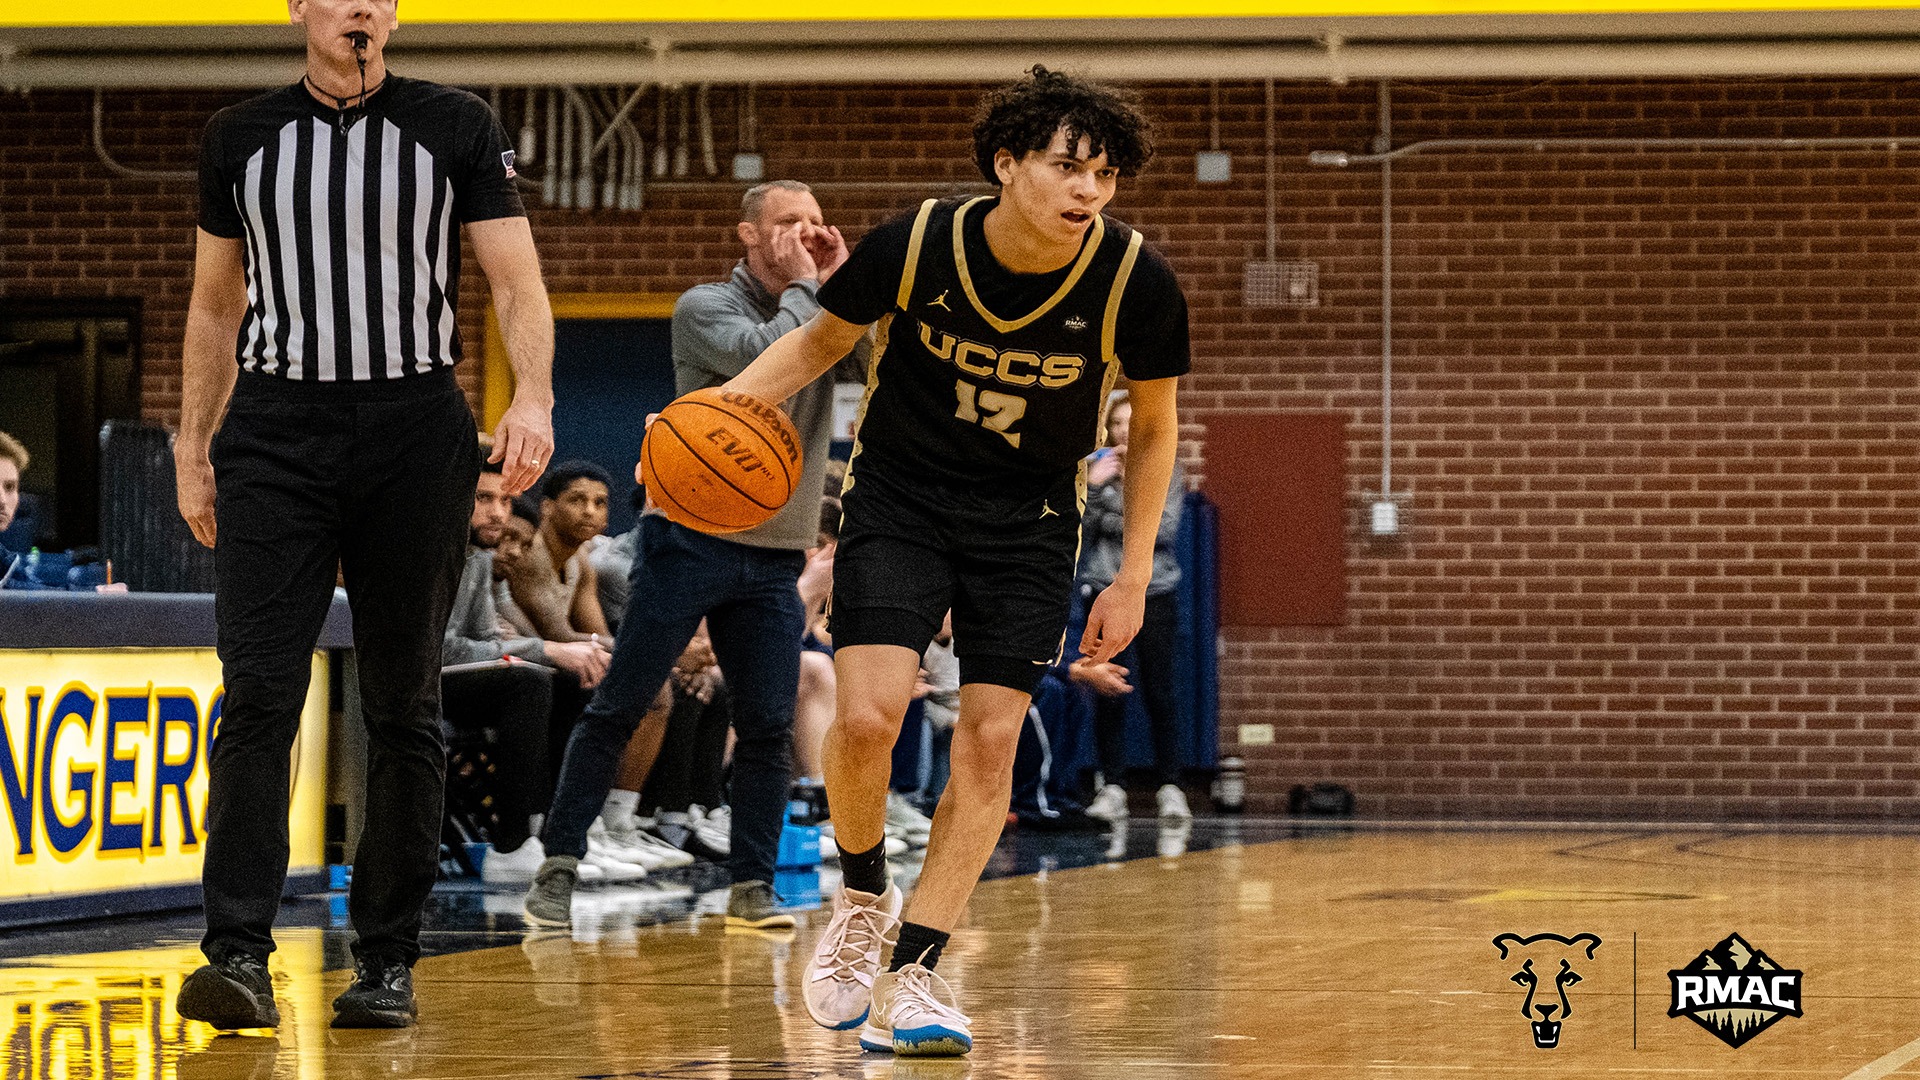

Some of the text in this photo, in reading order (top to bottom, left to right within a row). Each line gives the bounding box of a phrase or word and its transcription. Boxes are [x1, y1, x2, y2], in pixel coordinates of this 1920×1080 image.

[917, 320, 1087, 389] UCCS
[1065, 320, 1087, 328] RMAC
[955, 379, 1027, 449] 12
[706, 426, 763, 472] EVO
[0, 681, 224, 863] NGER
